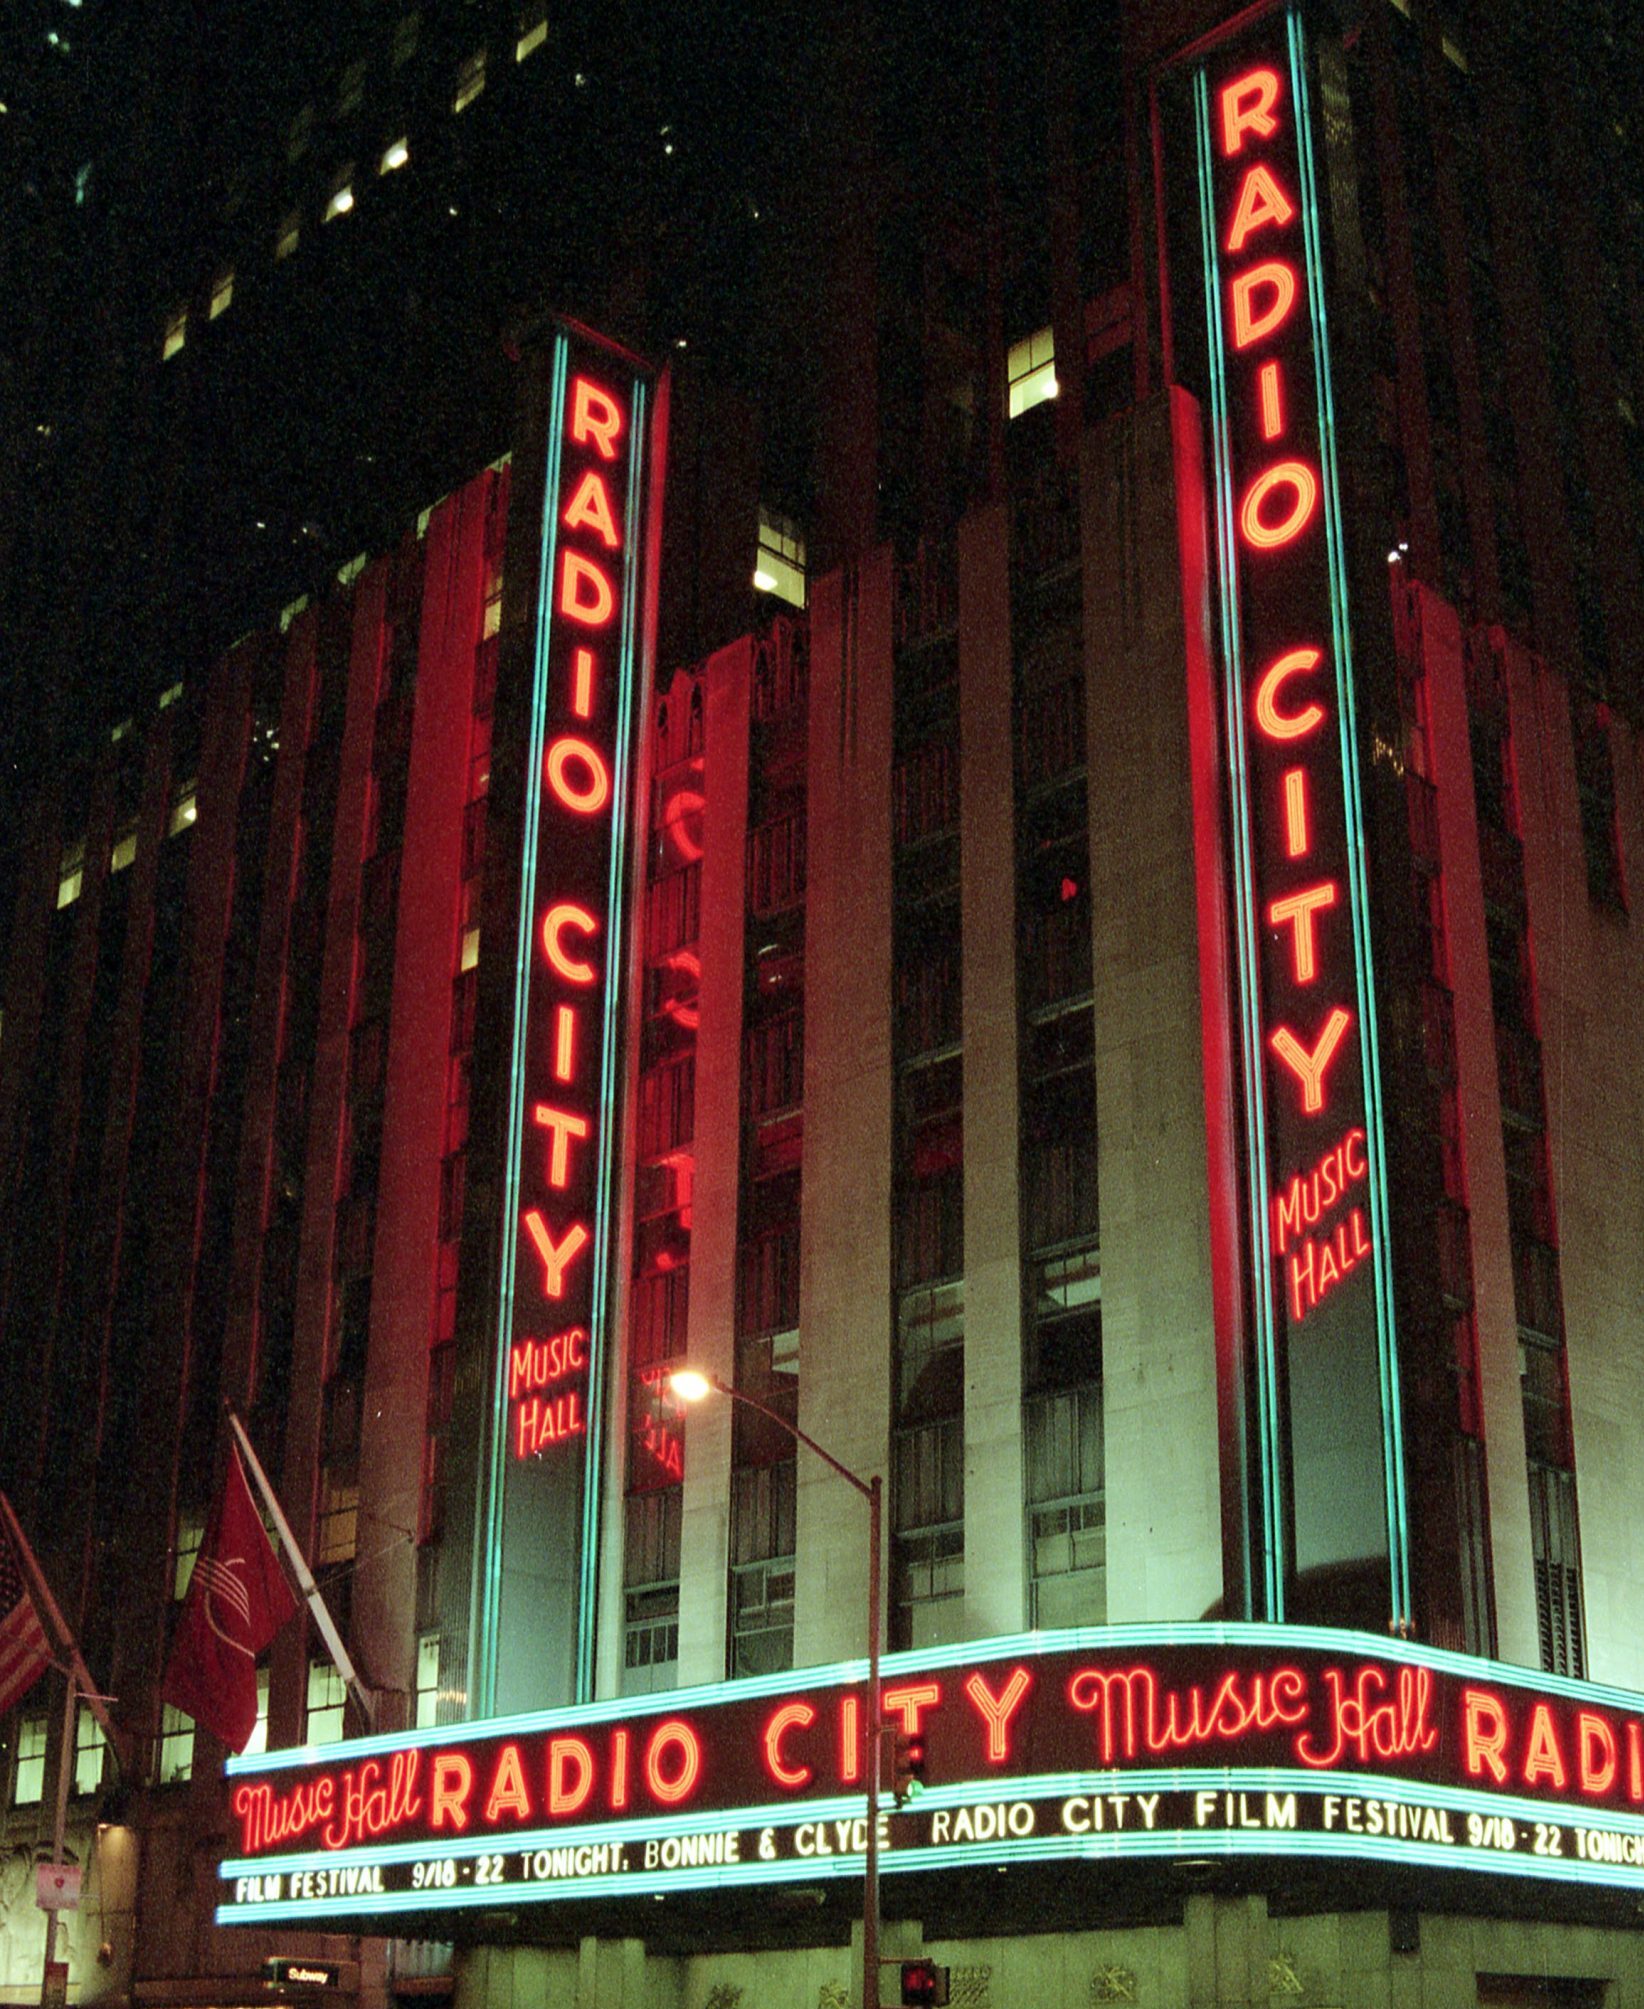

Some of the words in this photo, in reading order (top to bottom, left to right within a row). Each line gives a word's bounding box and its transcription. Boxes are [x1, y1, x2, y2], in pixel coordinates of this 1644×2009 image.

[1221, 69, 1317, 549] RADIO
[546, 377, 621, 815] RADIO
[1256, 648, 1351, 1113] CITY
[524, 903, 598, 1299] CITY
[1277, 1130, 1367, 1254] MUSIC
[1291, 1210, 1372, 1320] HALL
[510, 1329, 584, 1398] MUSIC
[517, 1393, 582, 1458] HALL
[235, 1776, 334, 1853] Music
[325, 1747, 421, 1848] Hall
[432, 1721, 699, 1829] RADIO
[765, 1668, 1030, 1784] CITY
[1070, 1667, 1308, 1762] Music
[1298, 1667, 1437, 1766] Hall
[235, 1874, 281, 1903] FILM
[289, 1866, 385, 1900] FESTIVAL
[411, 1858, 457, 1889] 9/18
[475, 1854, 504, 1885] 22
[644, 1831, 740, 1869] BONNIE
[758, 1827, 776, 1860] &
[794, 1814, 890, 1856] CLYDE
[931, 1802, 1035, 1844] RADIO
[1062, 1794, 1160, 1832] CITY
[1194, 1791, 1296, 1829] FILM
[1322, 1795, 1455, 1844] FESTIVAL
[1467, 1813, 1516, 1850] 9/18
[1533, 1823, 1564, 1857] 22
[288, 1967, 328, 1985] Subway
